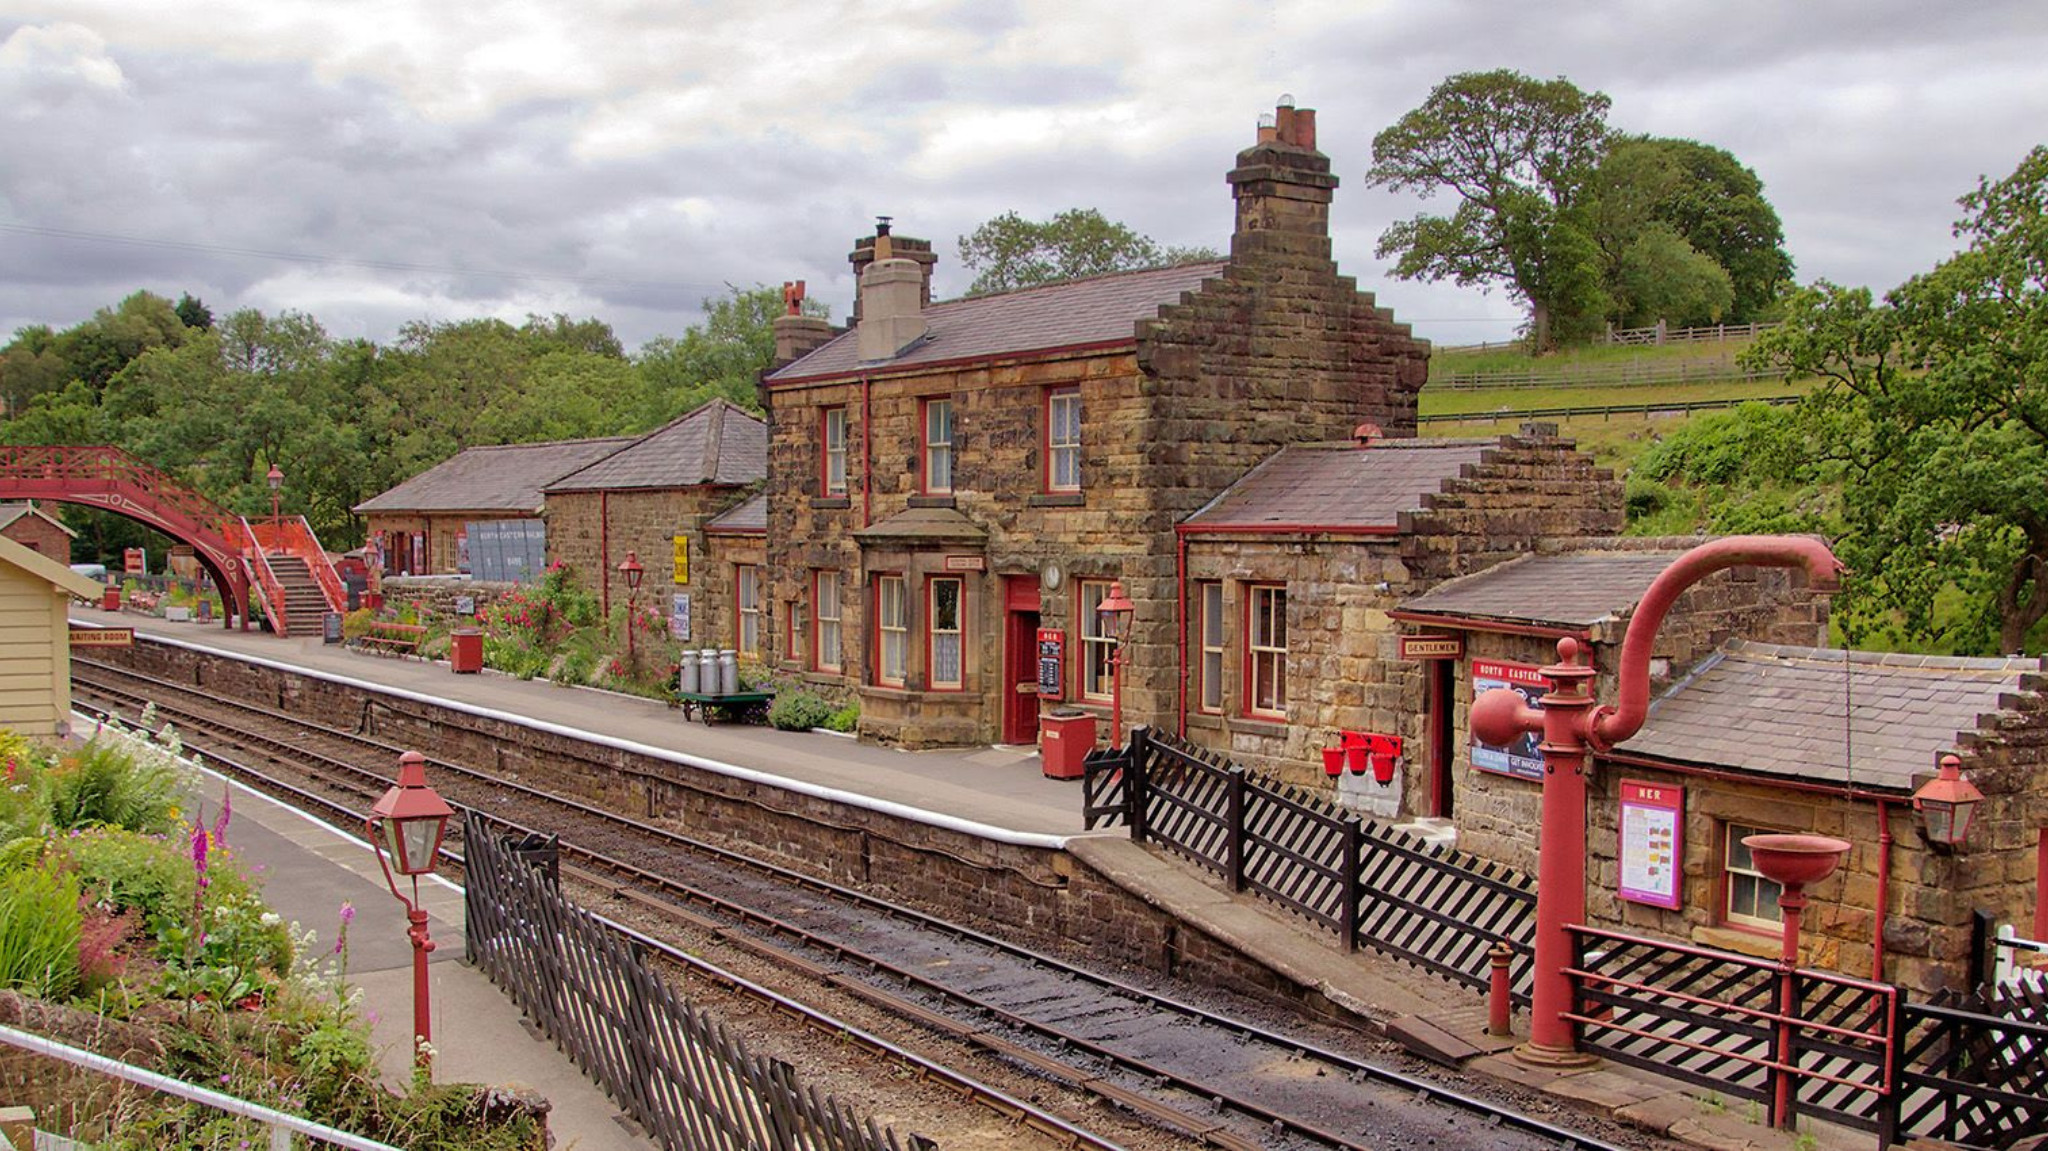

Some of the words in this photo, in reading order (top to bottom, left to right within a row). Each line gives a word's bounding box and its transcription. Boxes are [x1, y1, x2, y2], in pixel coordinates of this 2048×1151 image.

[104, 632, 128, 641] ROOM
[1407, 643, 1457, 652] GENTLEMEN
[1480, 664, 1502, 677] NORTH
[1509, 669, 1542, 681] EASTERN
[1639, 787, 1661, 800] NER
